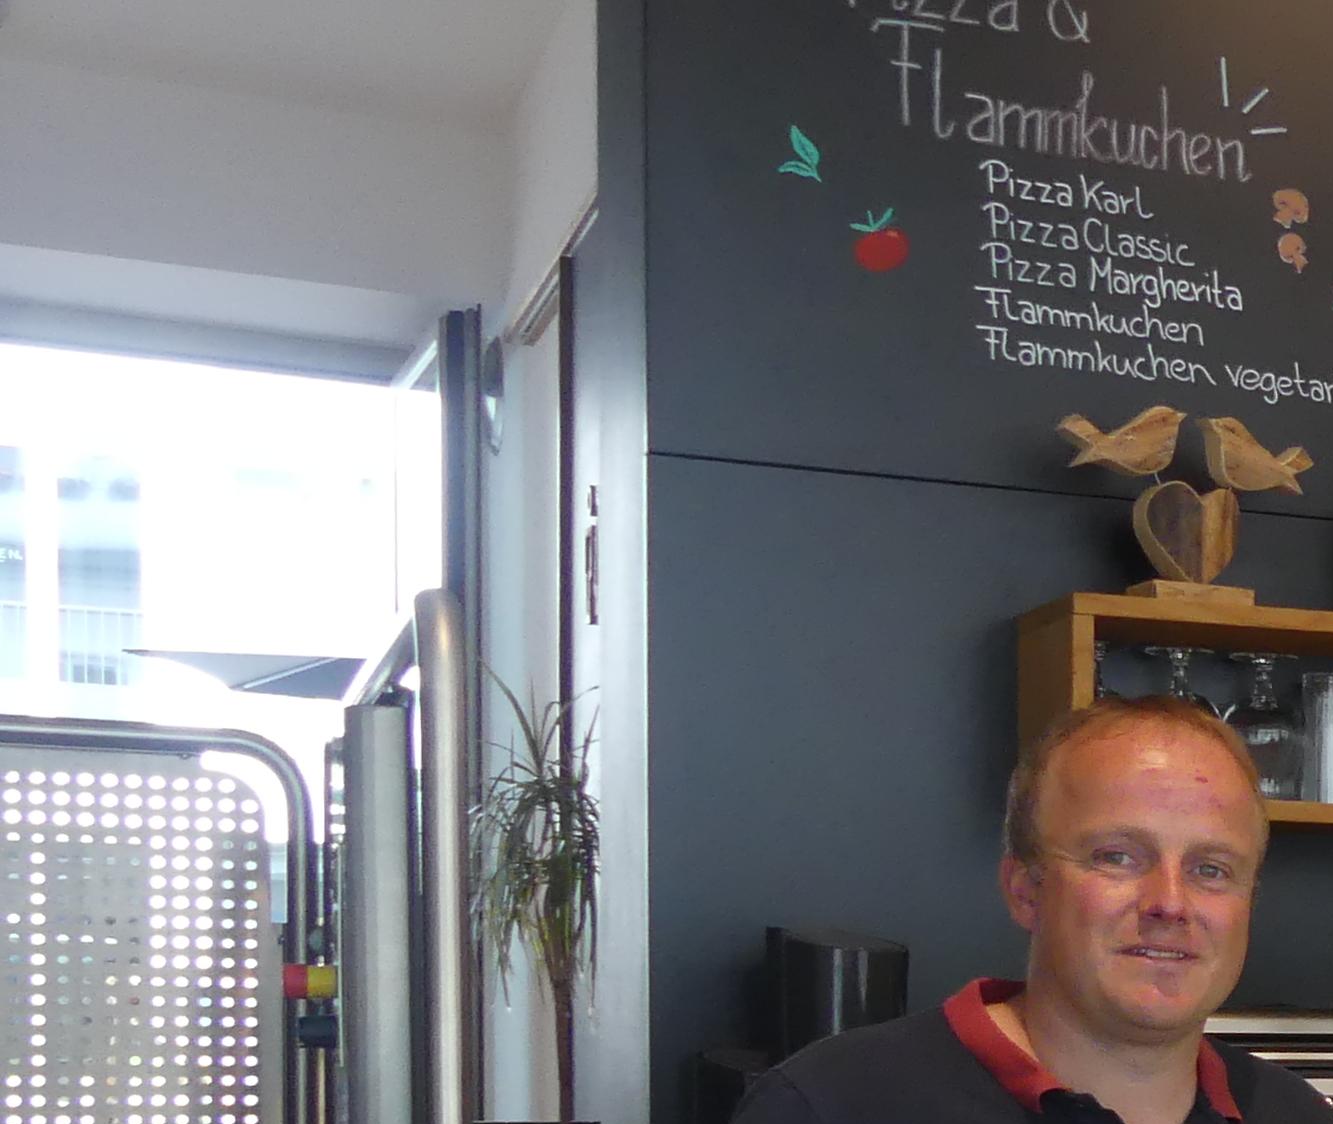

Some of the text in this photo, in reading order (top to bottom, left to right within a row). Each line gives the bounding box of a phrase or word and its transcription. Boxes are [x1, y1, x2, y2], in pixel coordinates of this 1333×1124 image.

[849, 0, 1019, 31] zza
[871, 18, 1252, 182] Flammkuchen
[979, 160, 1154, 219] Pizza Karl
[981, 202, 1196, 267] Pizza Classic
[980, 243, 1243, 311] Pizza Margherita
[975, 286, 1204, 346] Flammkuchen
[975, 326, 1216, 386] Flammkuchen
